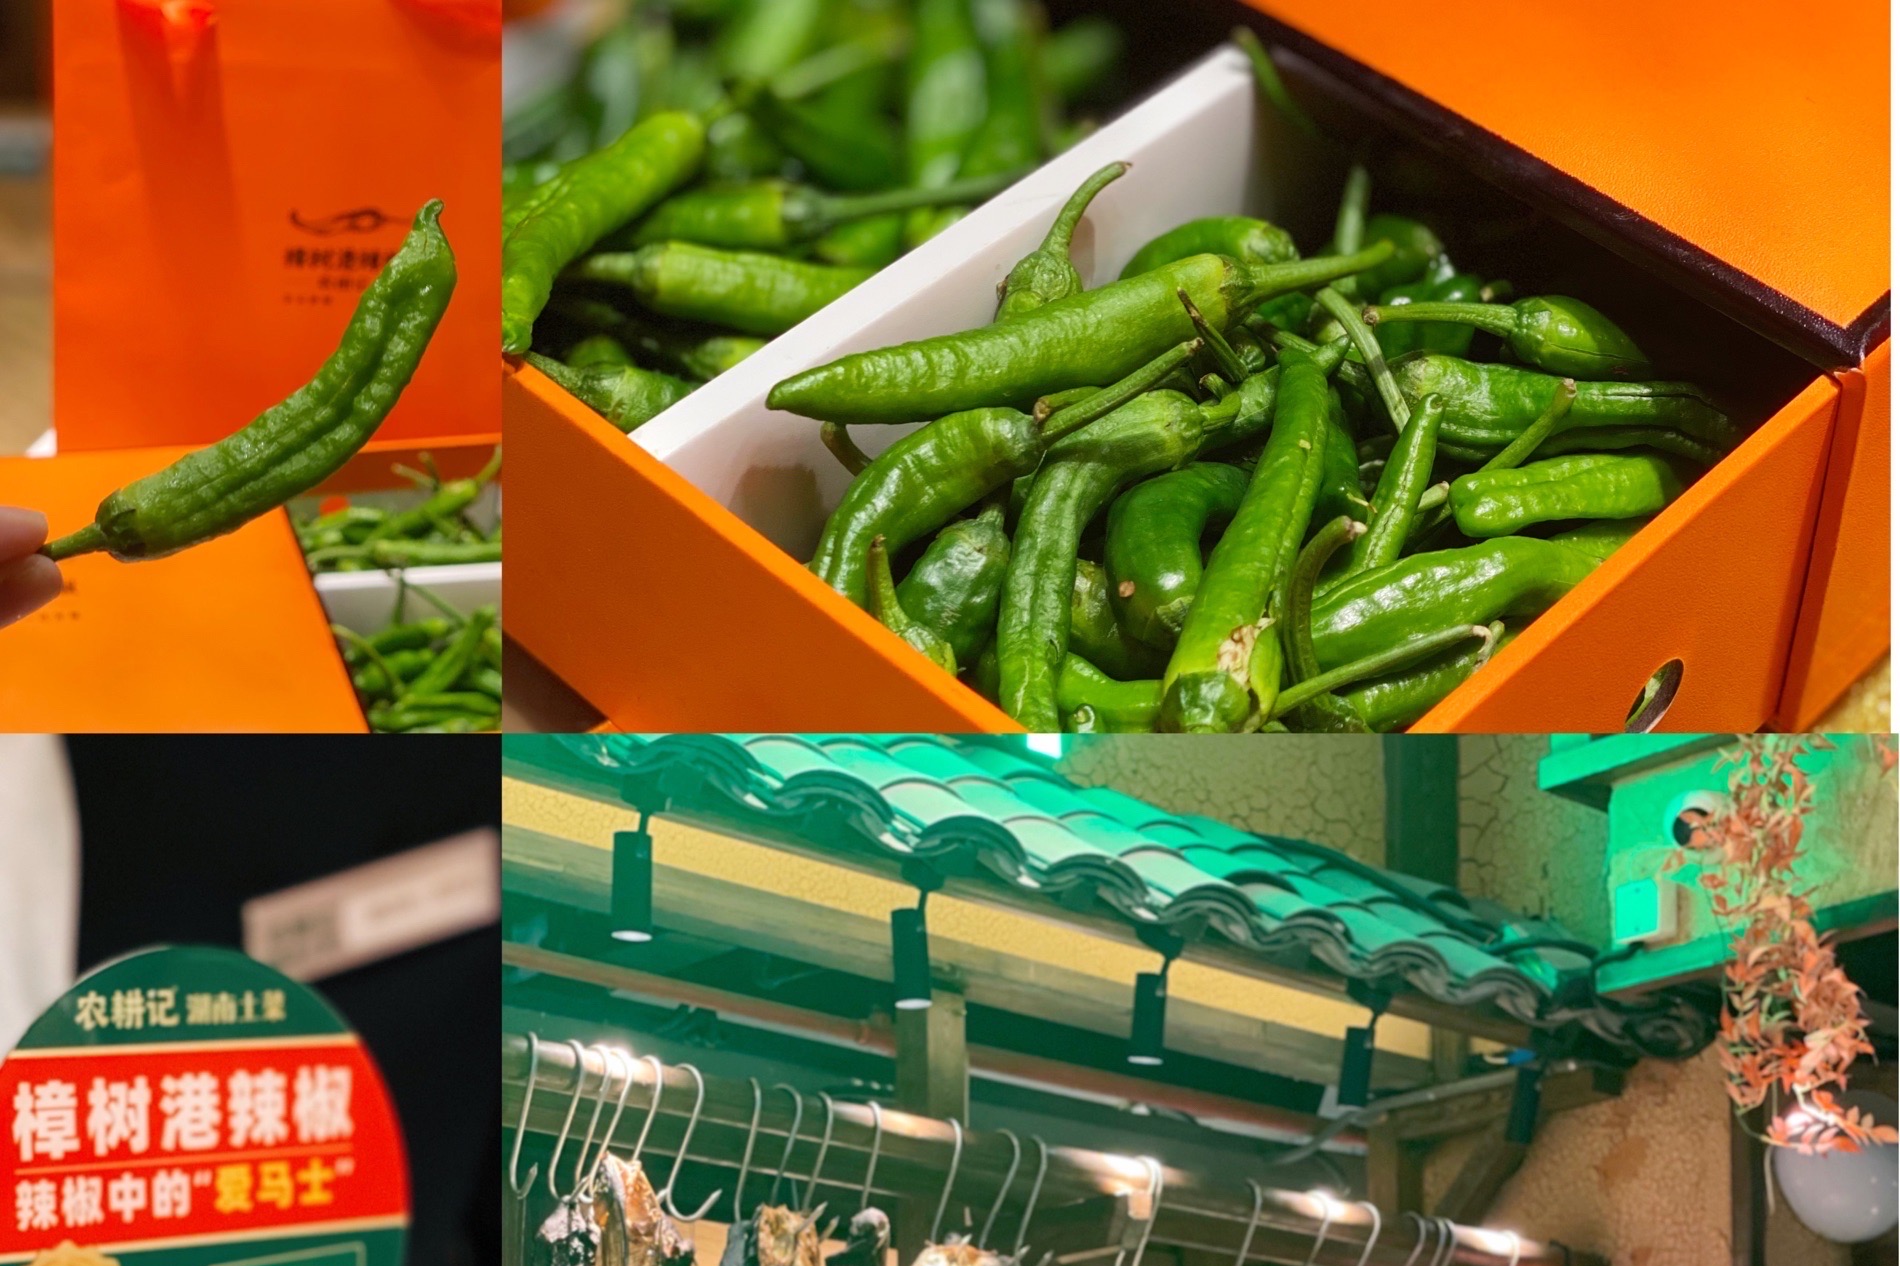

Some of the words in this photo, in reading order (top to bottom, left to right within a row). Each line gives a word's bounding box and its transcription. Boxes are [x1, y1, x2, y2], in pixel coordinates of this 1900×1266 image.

[75, 988, 180, 1031] 农耕记
[12, 1063, 354, 1163] 樟树港辣椒
